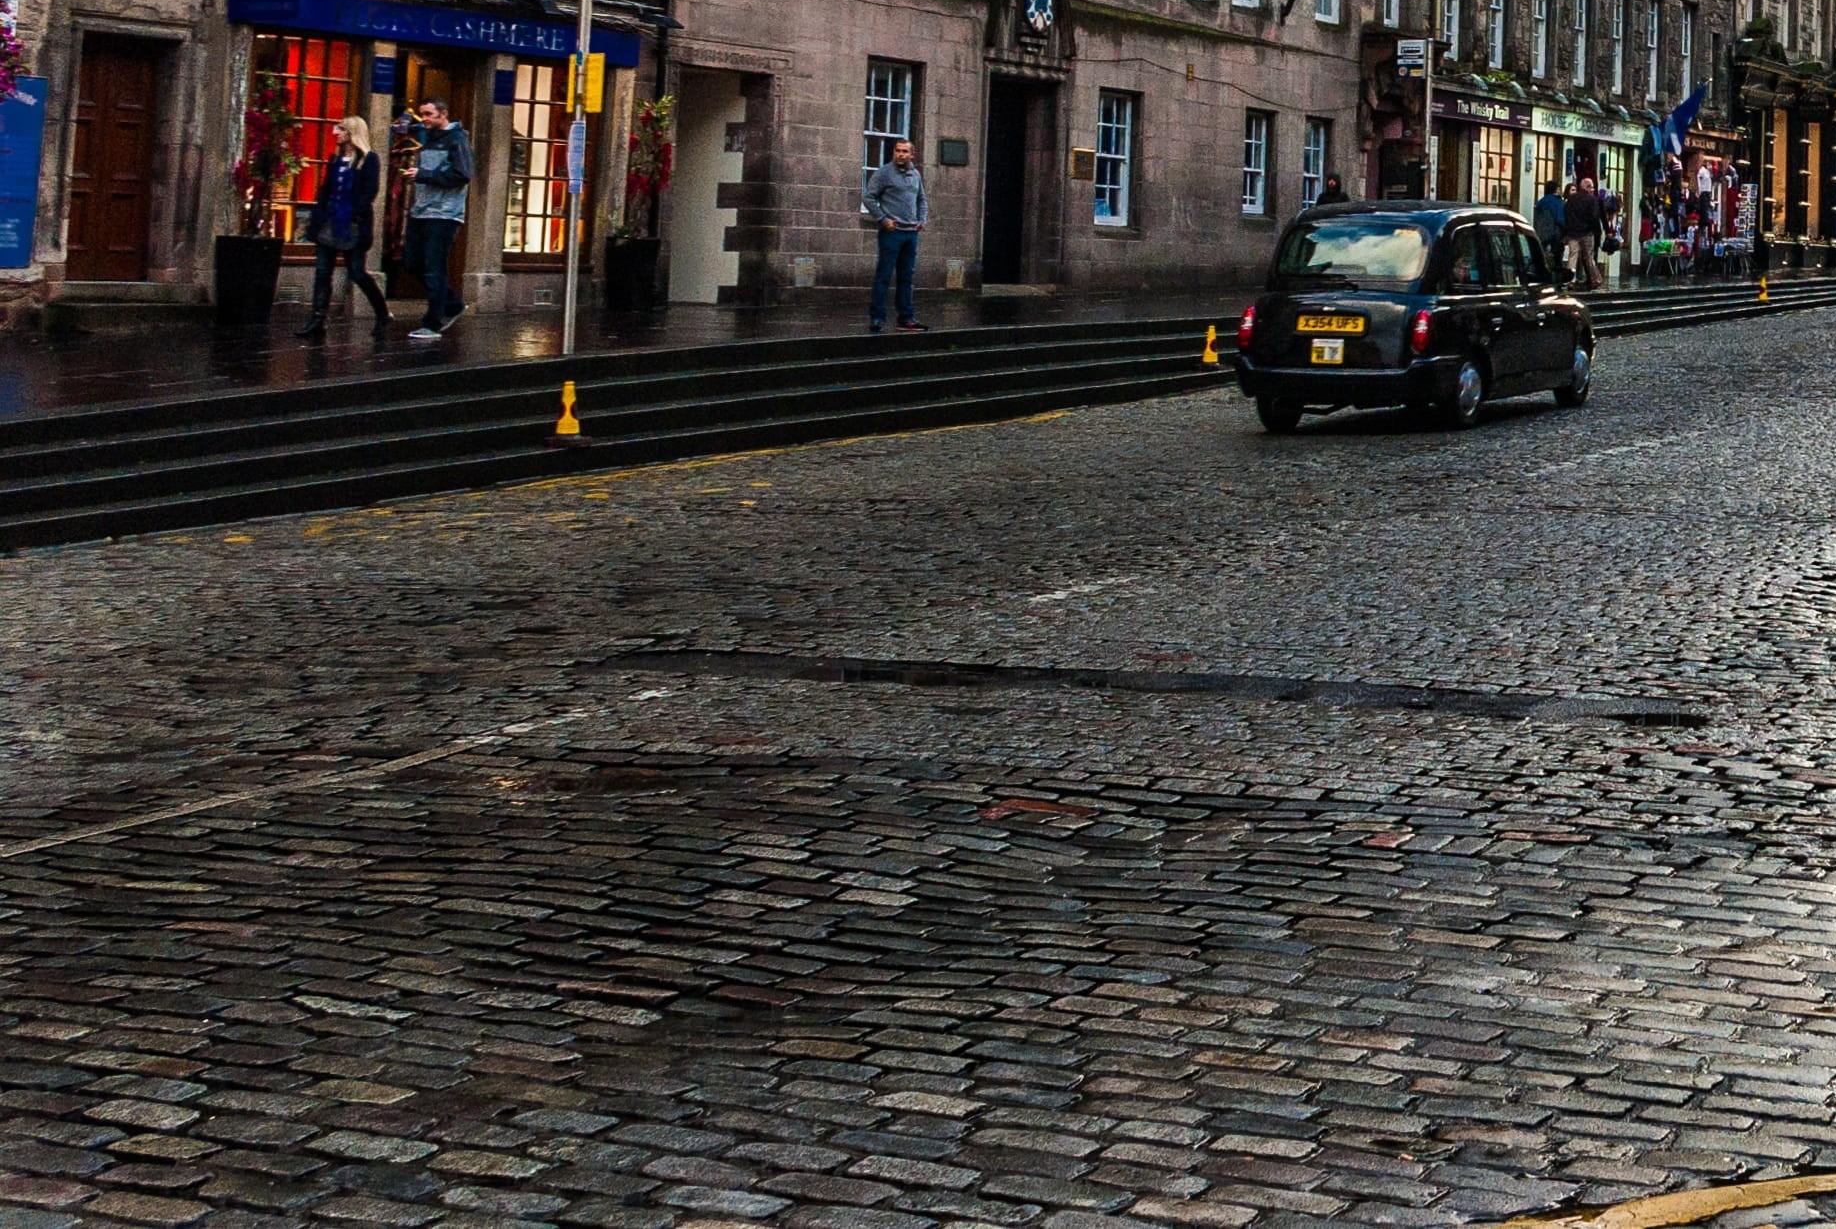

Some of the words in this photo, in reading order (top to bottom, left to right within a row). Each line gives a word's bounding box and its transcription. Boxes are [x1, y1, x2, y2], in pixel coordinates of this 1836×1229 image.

[1457, 99, 1469, 114] The
[1470, 101, 1493, 121] Whisky
[1494, 104, 1510, 120] Trail
